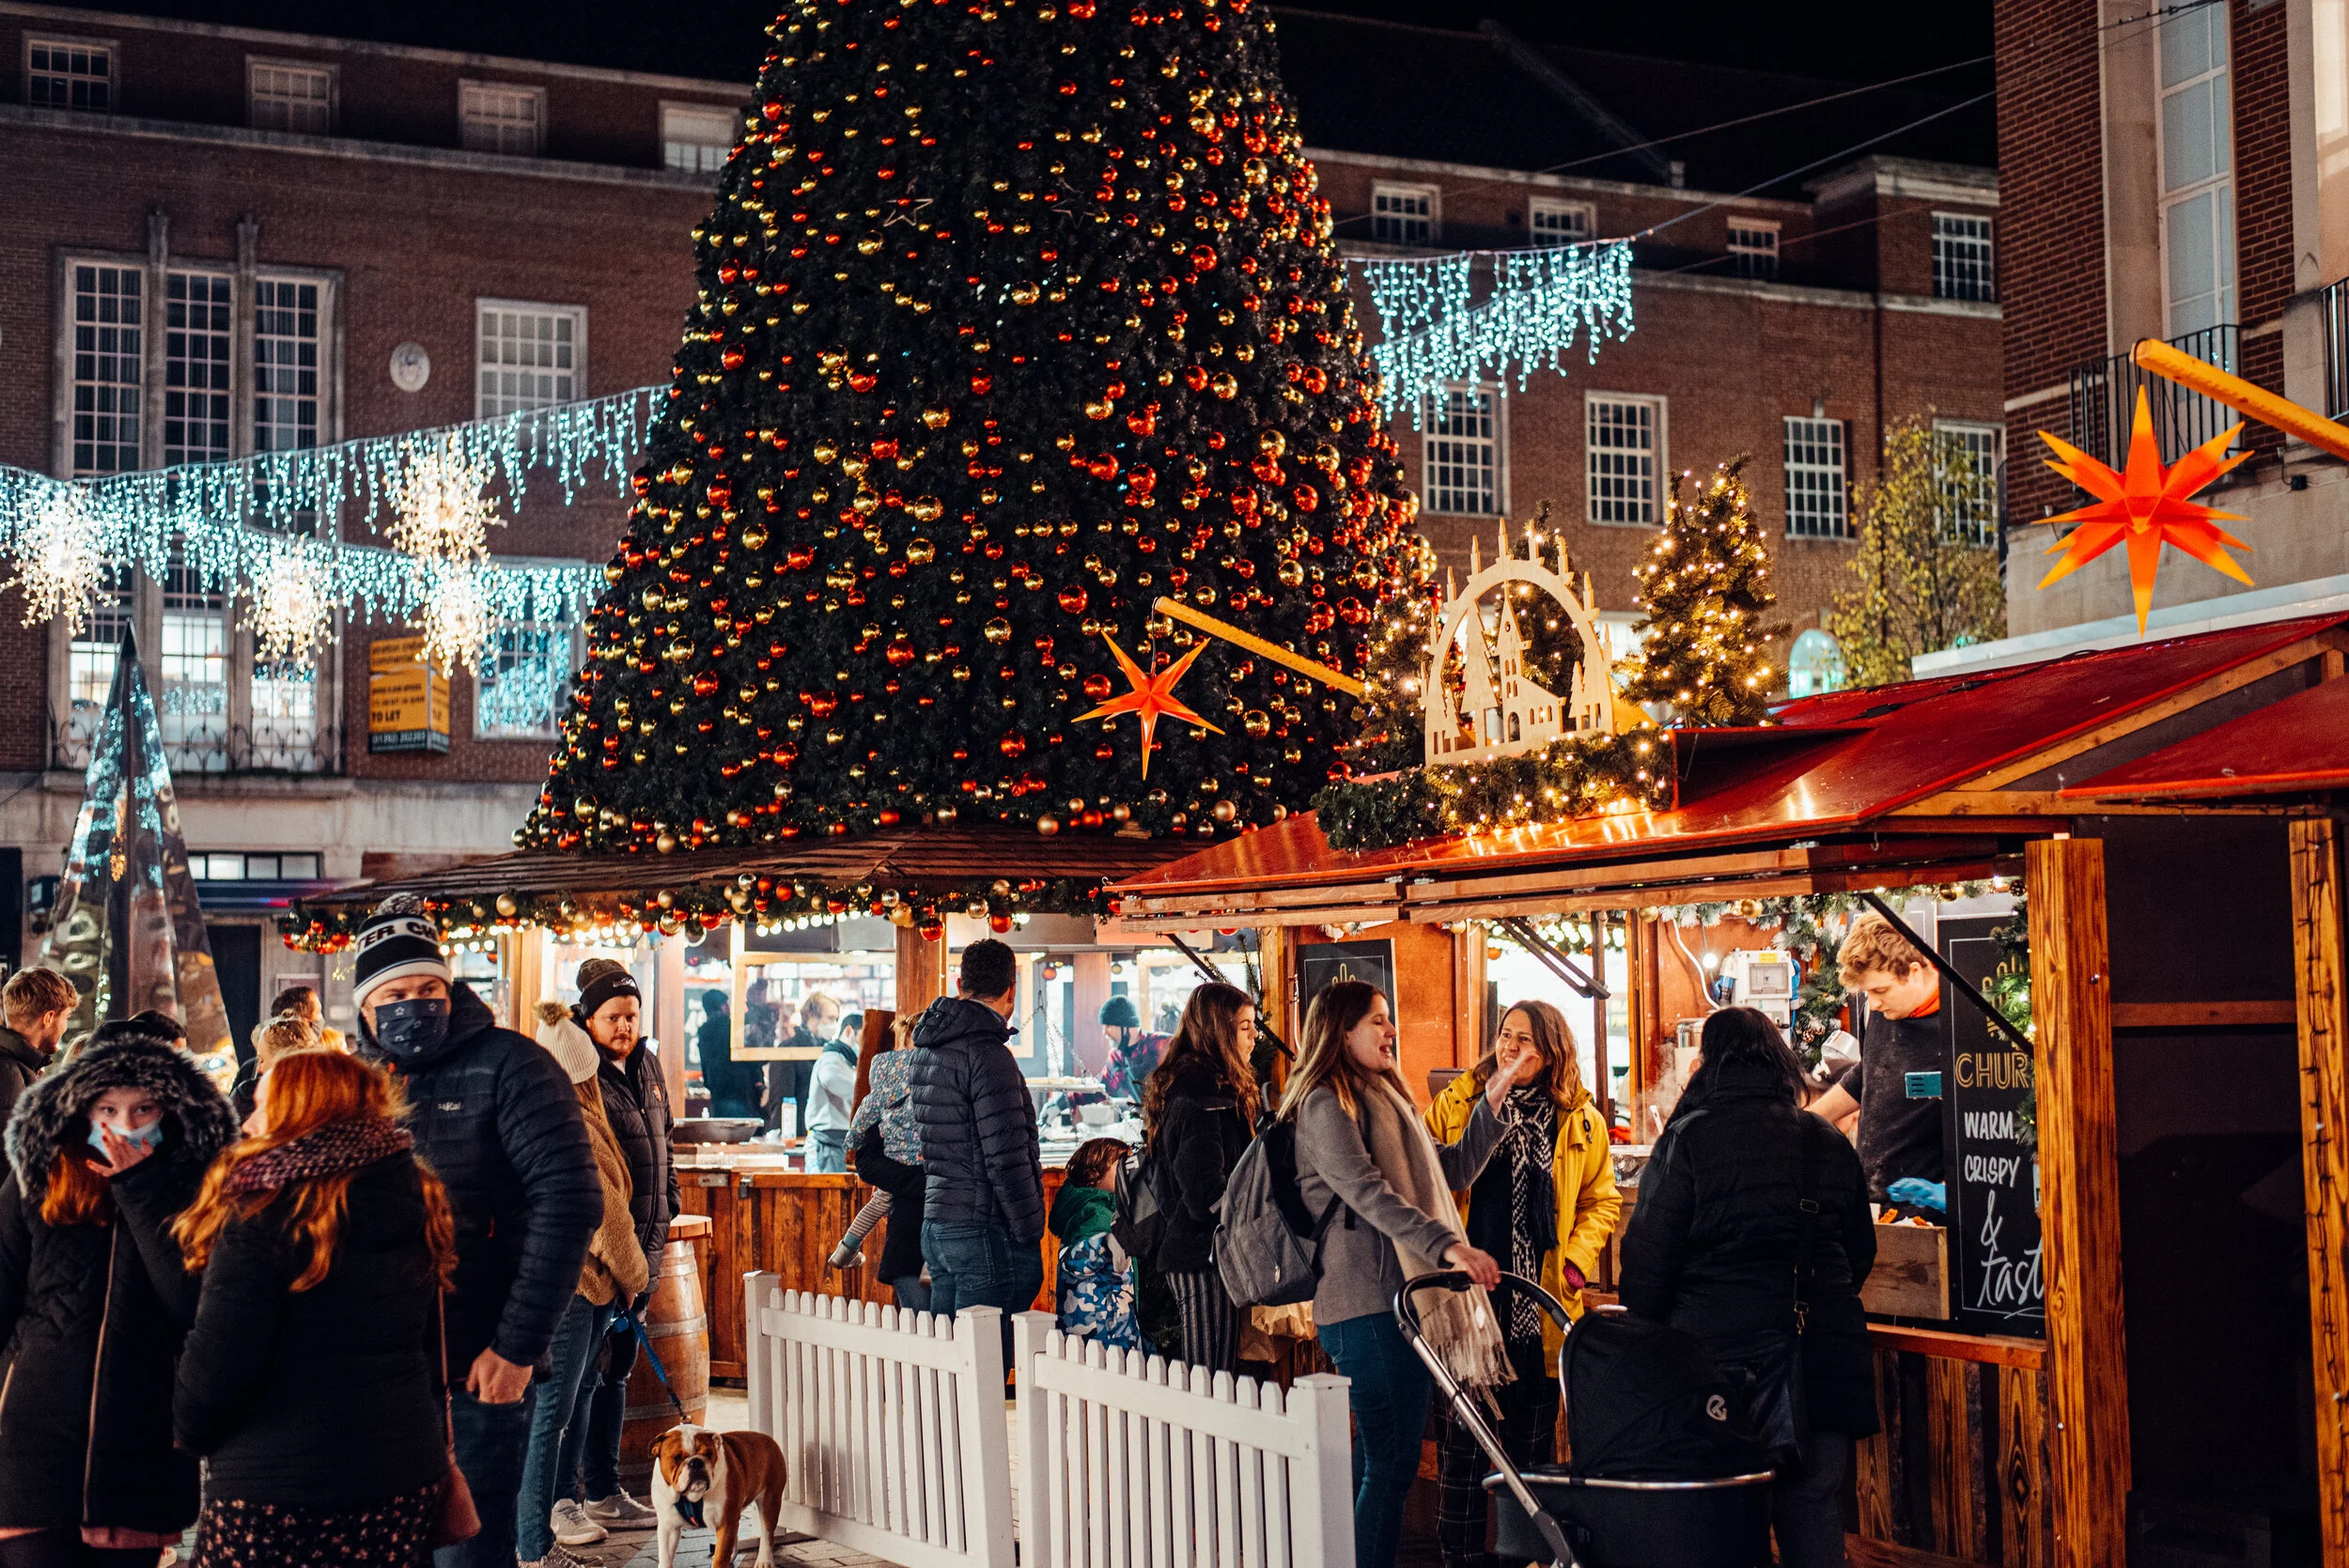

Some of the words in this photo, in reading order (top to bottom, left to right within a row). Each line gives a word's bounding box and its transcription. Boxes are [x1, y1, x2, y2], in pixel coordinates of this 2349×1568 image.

[1955, 1051, 2033, 1090] CHUR
[1965, 1110, 2020, 1144] WARM,
[1965, 1154, 2021, 1188] CRISPY
[1980, 1189, 2003, 1251] &
